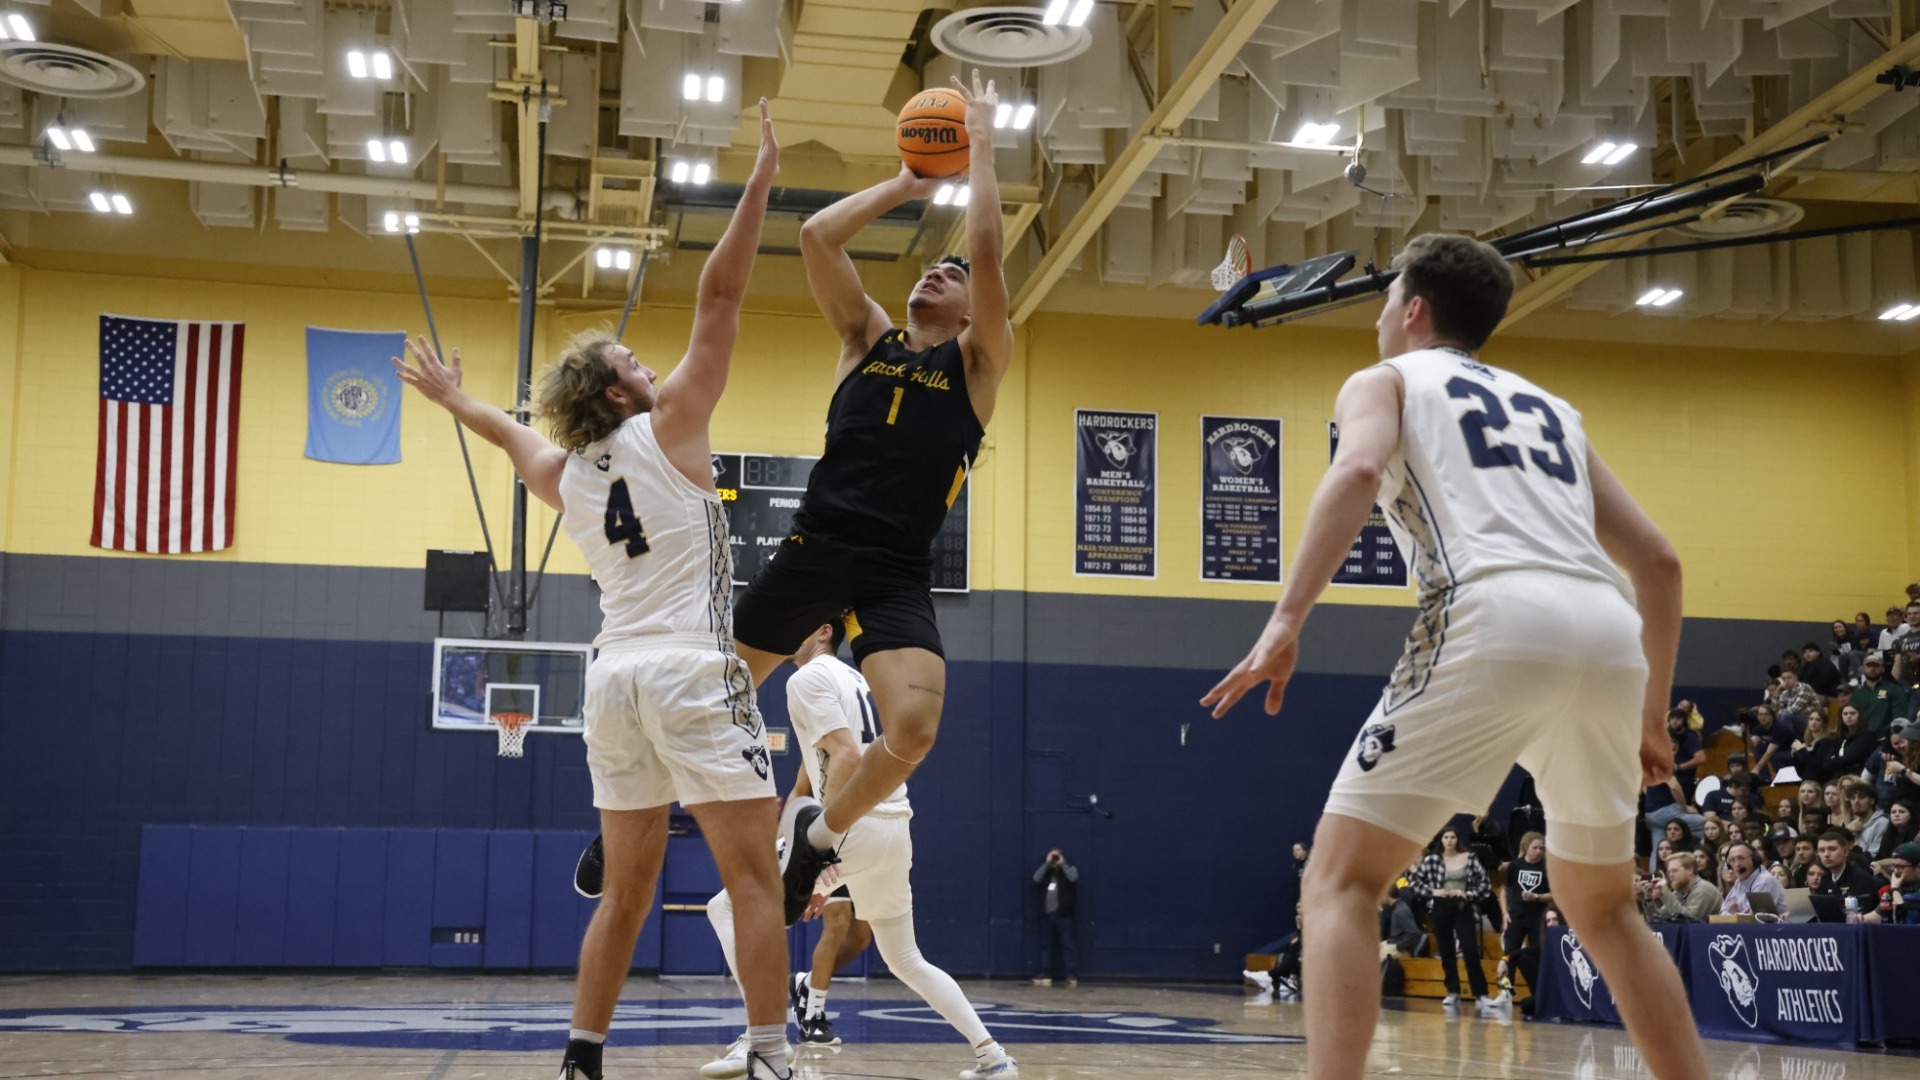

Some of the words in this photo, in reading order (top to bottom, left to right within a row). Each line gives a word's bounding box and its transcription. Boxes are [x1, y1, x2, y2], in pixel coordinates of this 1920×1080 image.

[902, 127, 959, 144] Wilson
[886, 386, 904, 426] 1
[1079, 414, 1154, 430] HARDROCKERS
[1206, 422, 1276, 448] HARDROCKER
[1445, 376, 1577, 486] 23
[1086, 478, 1145, 488] BASKETBALL
[1100, 470, 1131, 479] MEN'S
[1219, 476, 1264, 486] WOMEN'S
[1212, 484, 1271, 494] BASKETBALL
[769, 497, 801, 509] PERIOD
[604, 477, 650, 560] 4
[1755, 937, 1844, 972] HARDROCKER
[1777, 987, 1844, 1024] ATHLETICS
